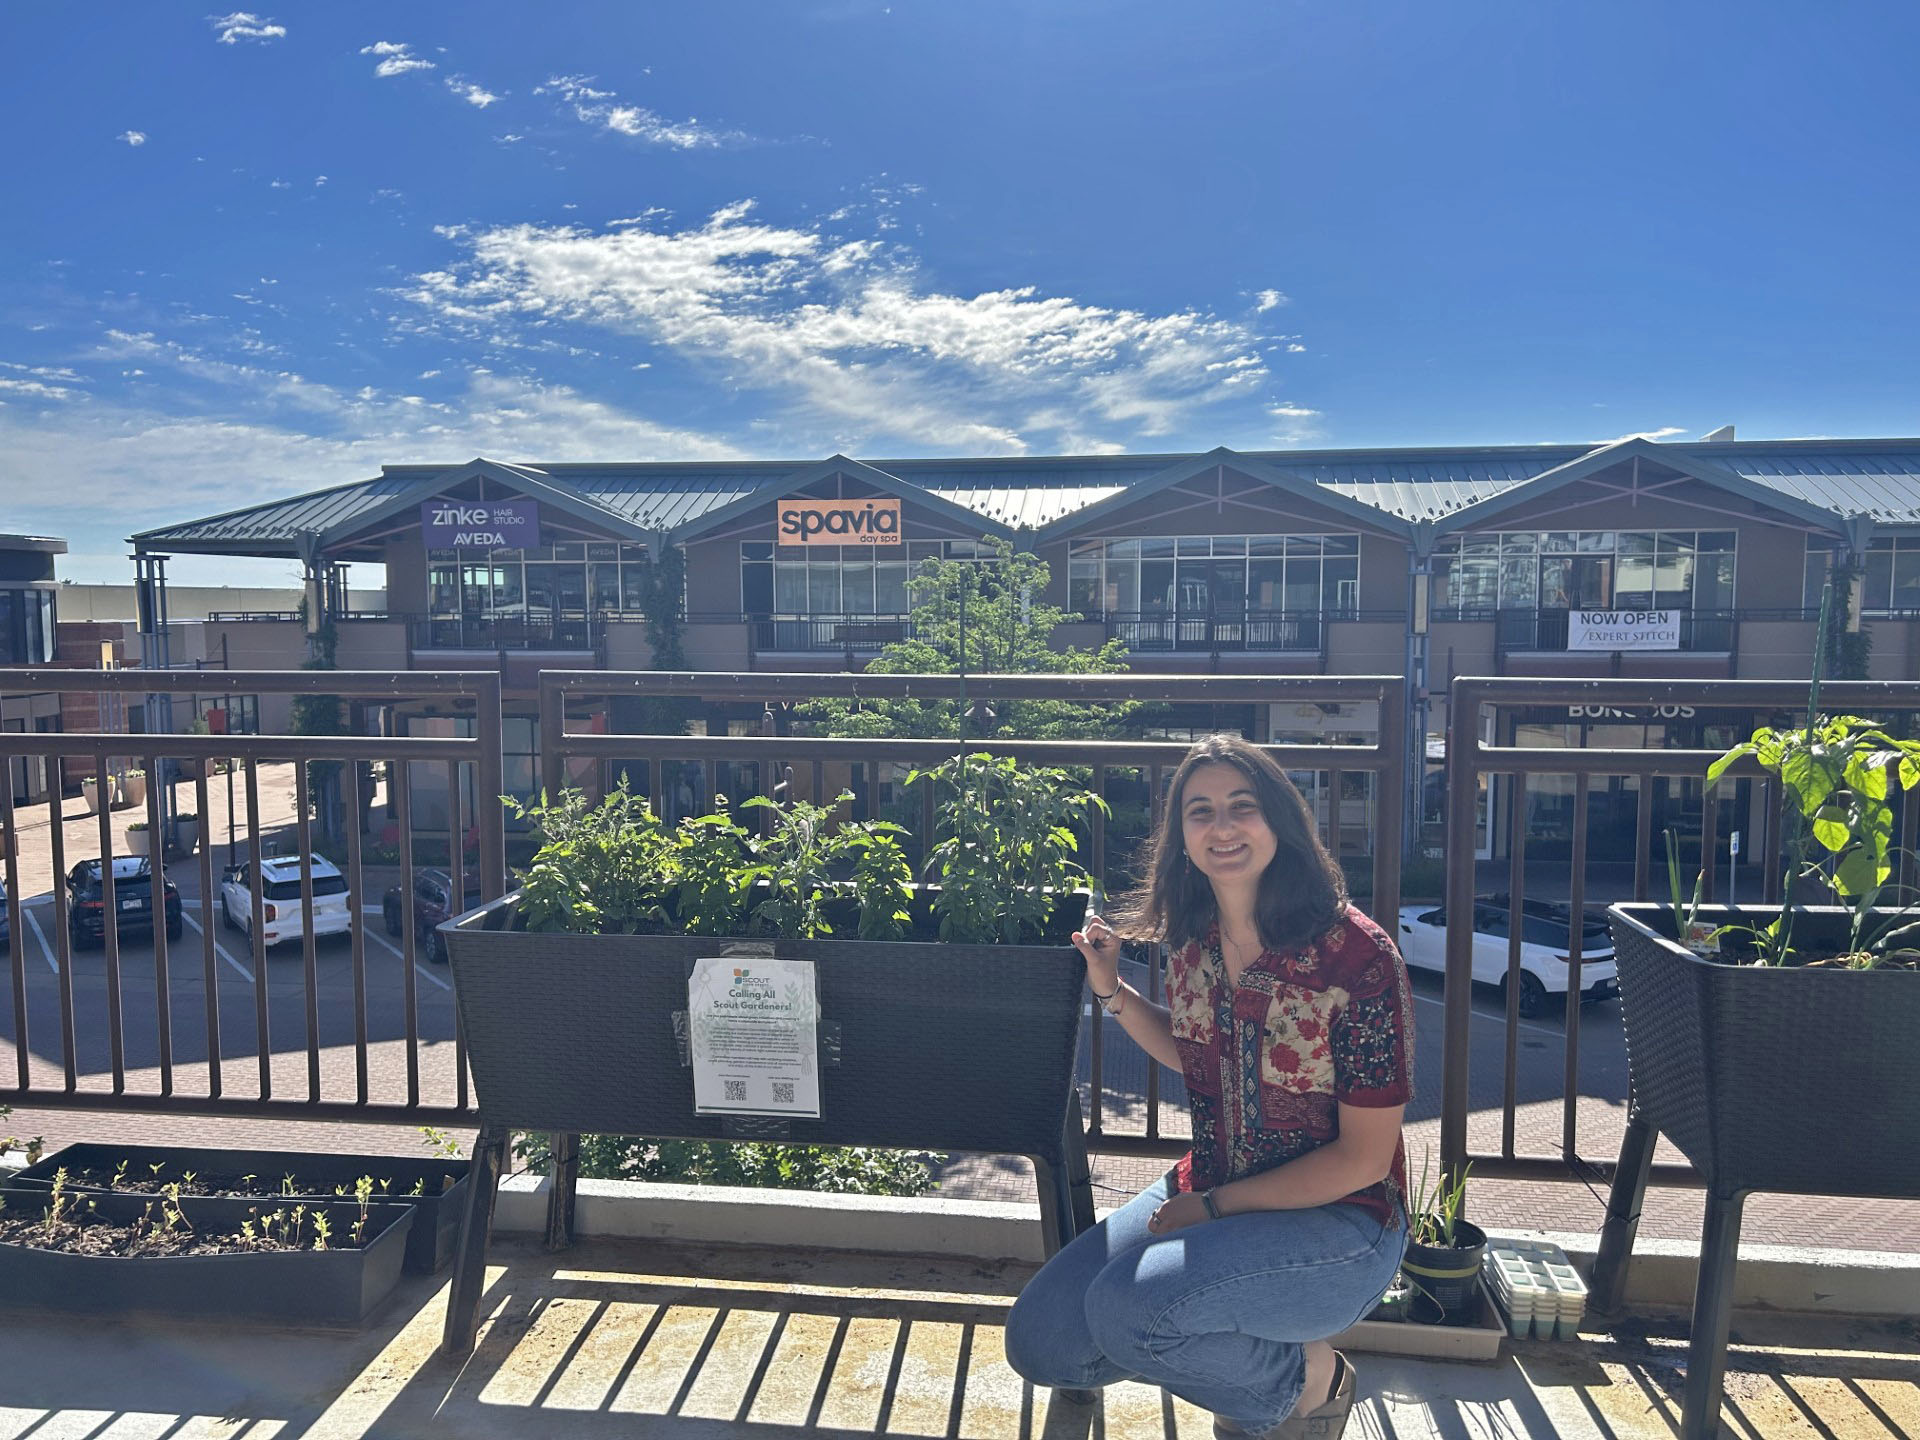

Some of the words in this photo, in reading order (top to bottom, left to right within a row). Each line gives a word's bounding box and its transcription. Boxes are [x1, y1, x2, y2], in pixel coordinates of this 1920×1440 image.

[431, 504, 489, 526] zinke
[493, 508, 513, 517] HAIR
[493, 516, 525, 525] STUDIO
[781, 503, 898, 541] spavia
[453, 533, 506, 545] AVEDA
[860, 535, 878, 544] day
[880, 535, 898, 544] spa
[1580, 612, 1619, 625] NOW
[1623, 612, 1669, 625] OPEN
[1588, 631, 1629, 641] EXPERT
[1633, 631, 1675, 641] STITCH
[728, 989, 761, 1000] Calling
[763, 990, 776, 999] All
[713, 1001, 739, 1009] Scout
[740, 1001, 792, 1012] Gardeners!
